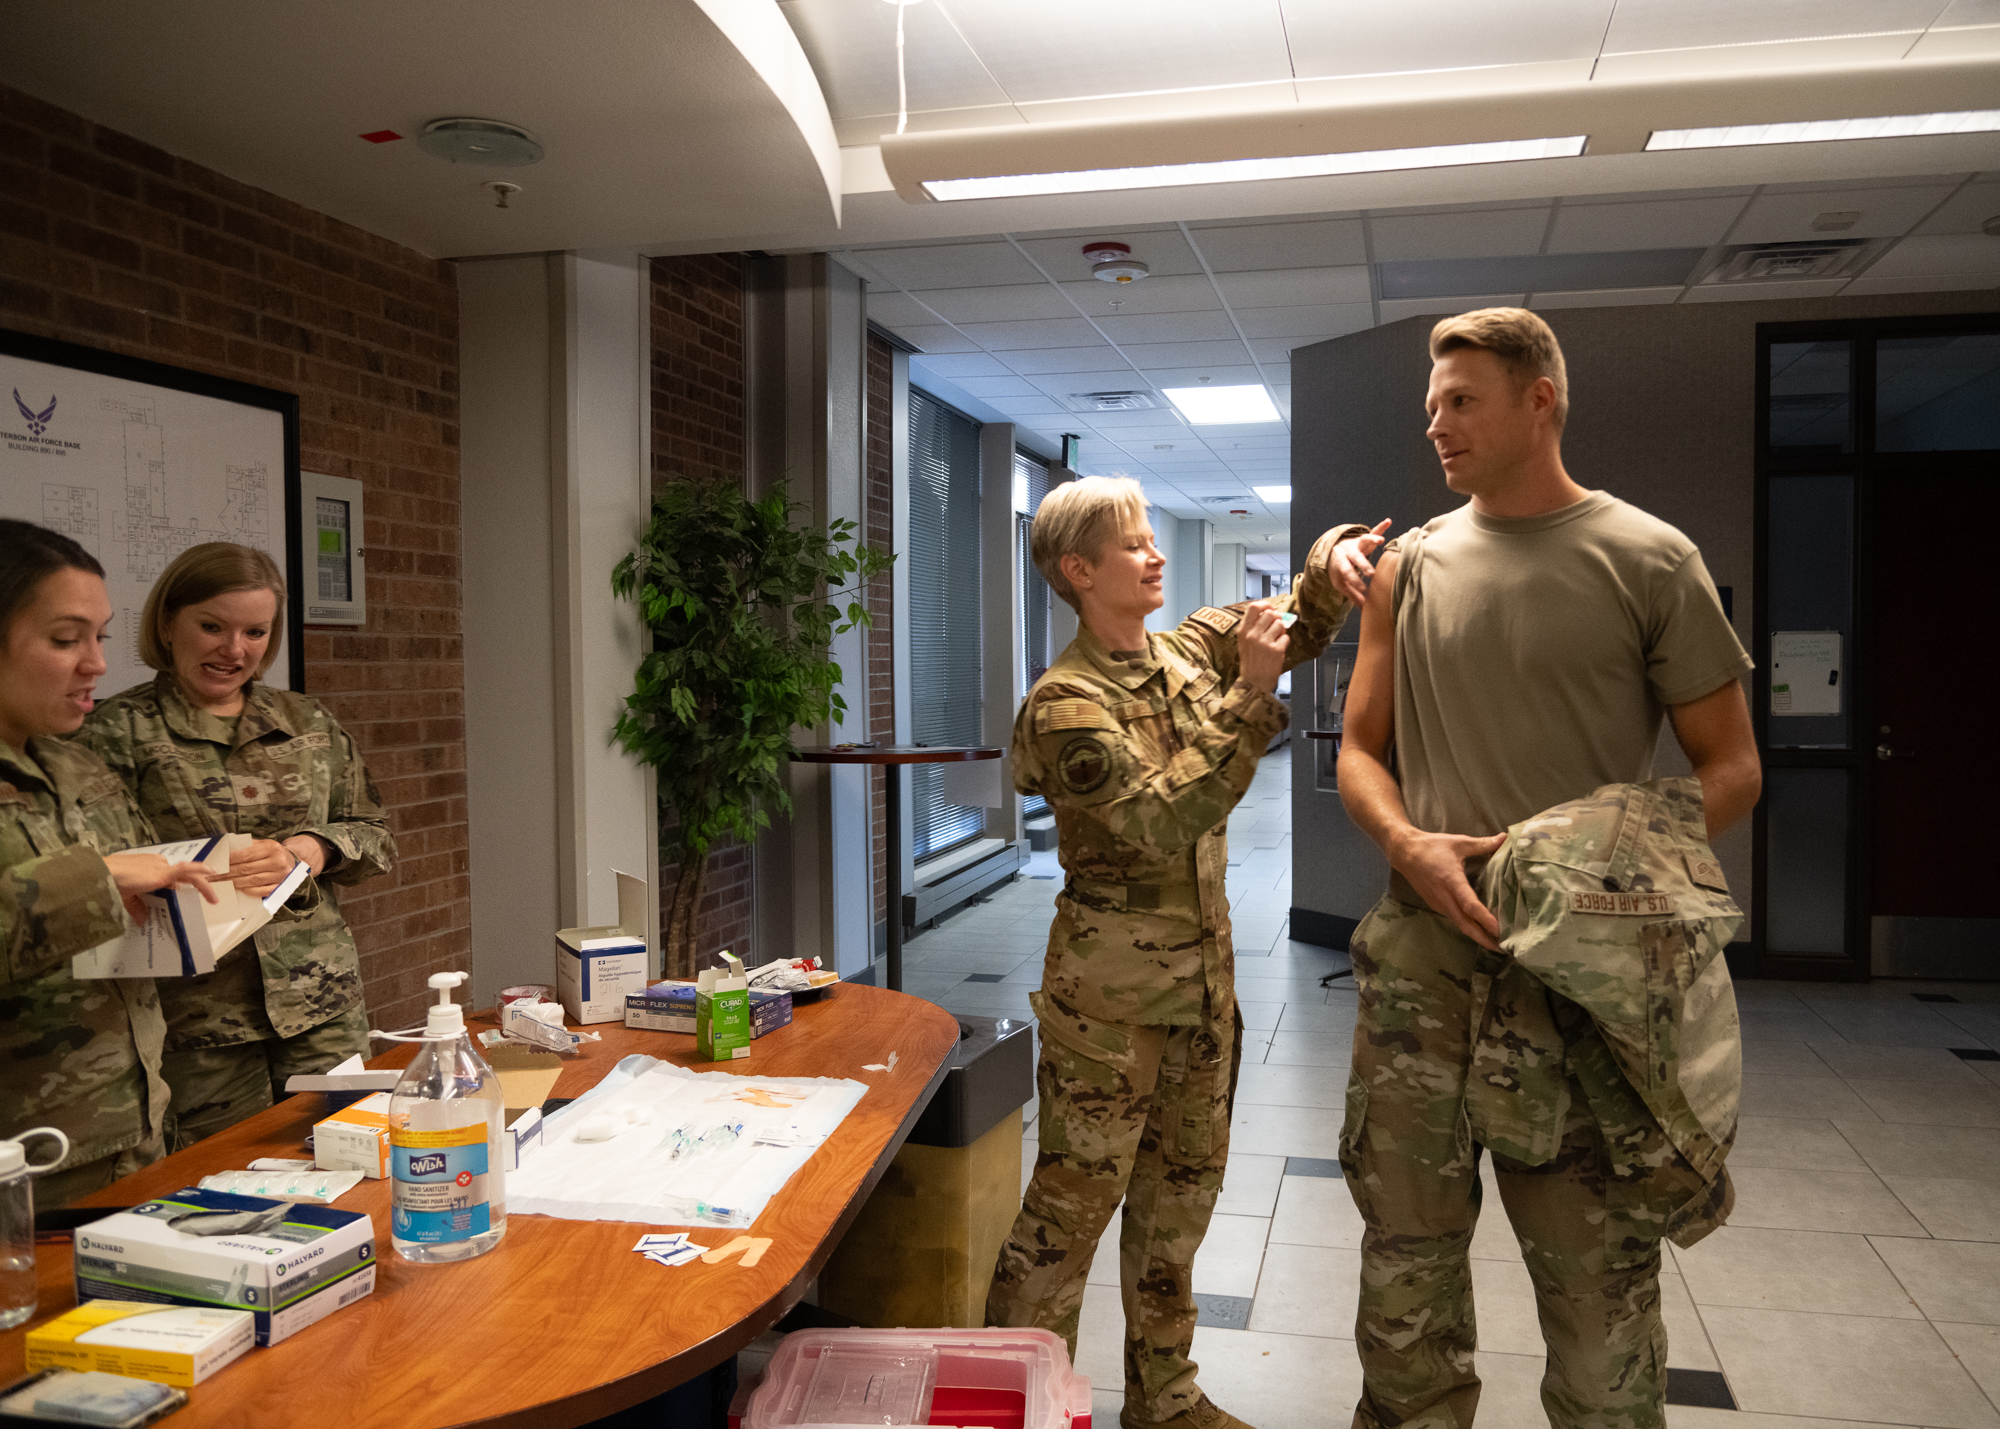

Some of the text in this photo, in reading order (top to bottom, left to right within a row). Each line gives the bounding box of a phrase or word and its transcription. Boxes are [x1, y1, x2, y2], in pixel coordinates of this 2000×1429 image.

[8, 442, 39, 453] BUILDING
[40, 447, 51, 455] 890
[56, 449, 67, 457] 895
[29, 436, 39, 444] AIR
[41, 438, 63, 447] FORCE
[64, 441, 81, 449] BASE
[1195, 608, 1233, 630] CCATT
[290, 739, 303, 749] AIR
[1575, 893, 1668, 911] U.S. AIR FORCE
[720, 999, 742, 1008] CURAD
[411, 1156, 445, 1173] Wish
[91, 1241, 124, 1253] HALYARD
[217, 1240, 265, 1252] HALYARD
[288, 1247, 324, 1270] HALYARD
